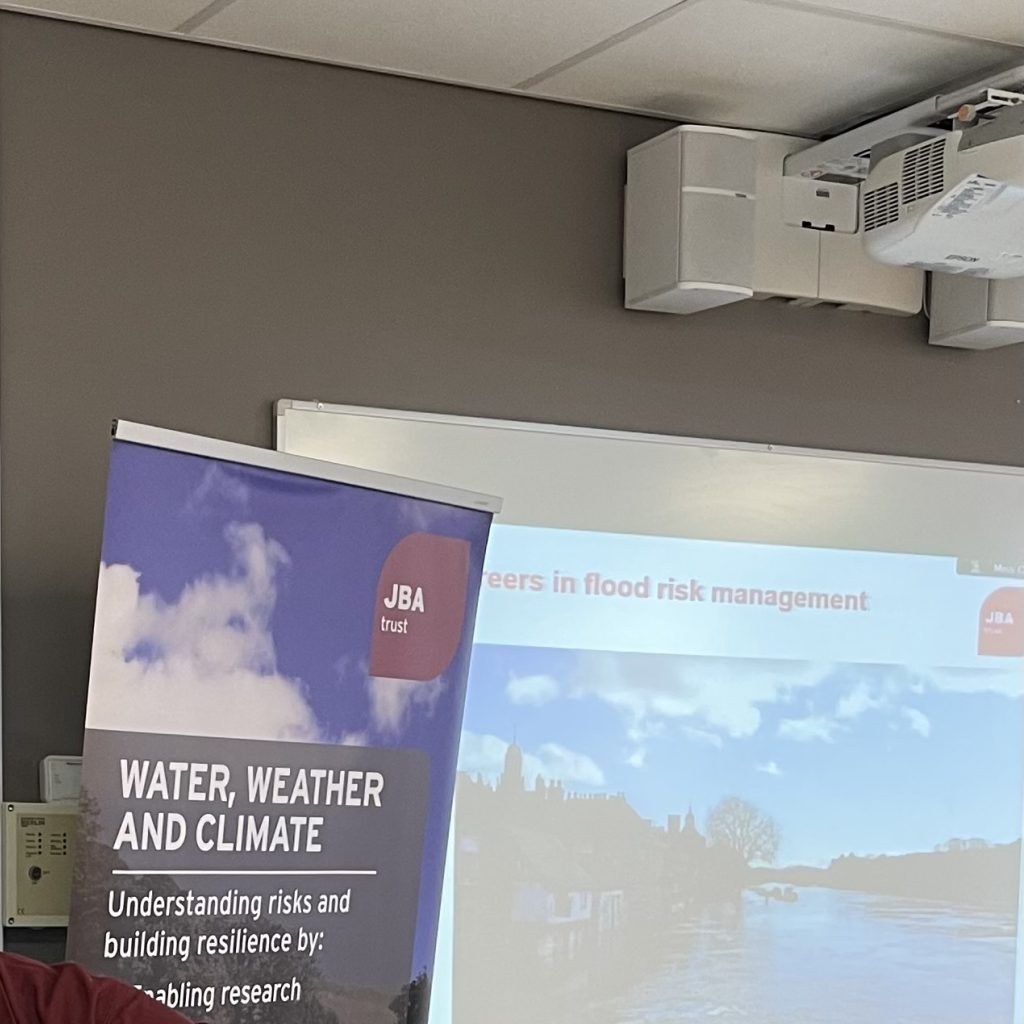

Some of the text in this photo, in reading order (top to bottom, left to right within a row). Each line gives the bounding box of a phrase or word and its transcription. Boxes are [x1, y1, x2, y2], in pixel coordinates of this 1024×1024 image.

[383, 583, 425, 613] JBA
[483, 570, 871, 612] eers in flood risk management
[380, 616, 409, 634] trust
[985, 610, 1014, 625] JBA
[120, 759, 384, 808] WATER, WEATHER
[113, 811, 324, 852] AND CLIMATE
[108, 889, 351, 921] Understanding risks and
[104, 928, 324, 962] building resilience by:
[221, 977, 301, 1005] research
